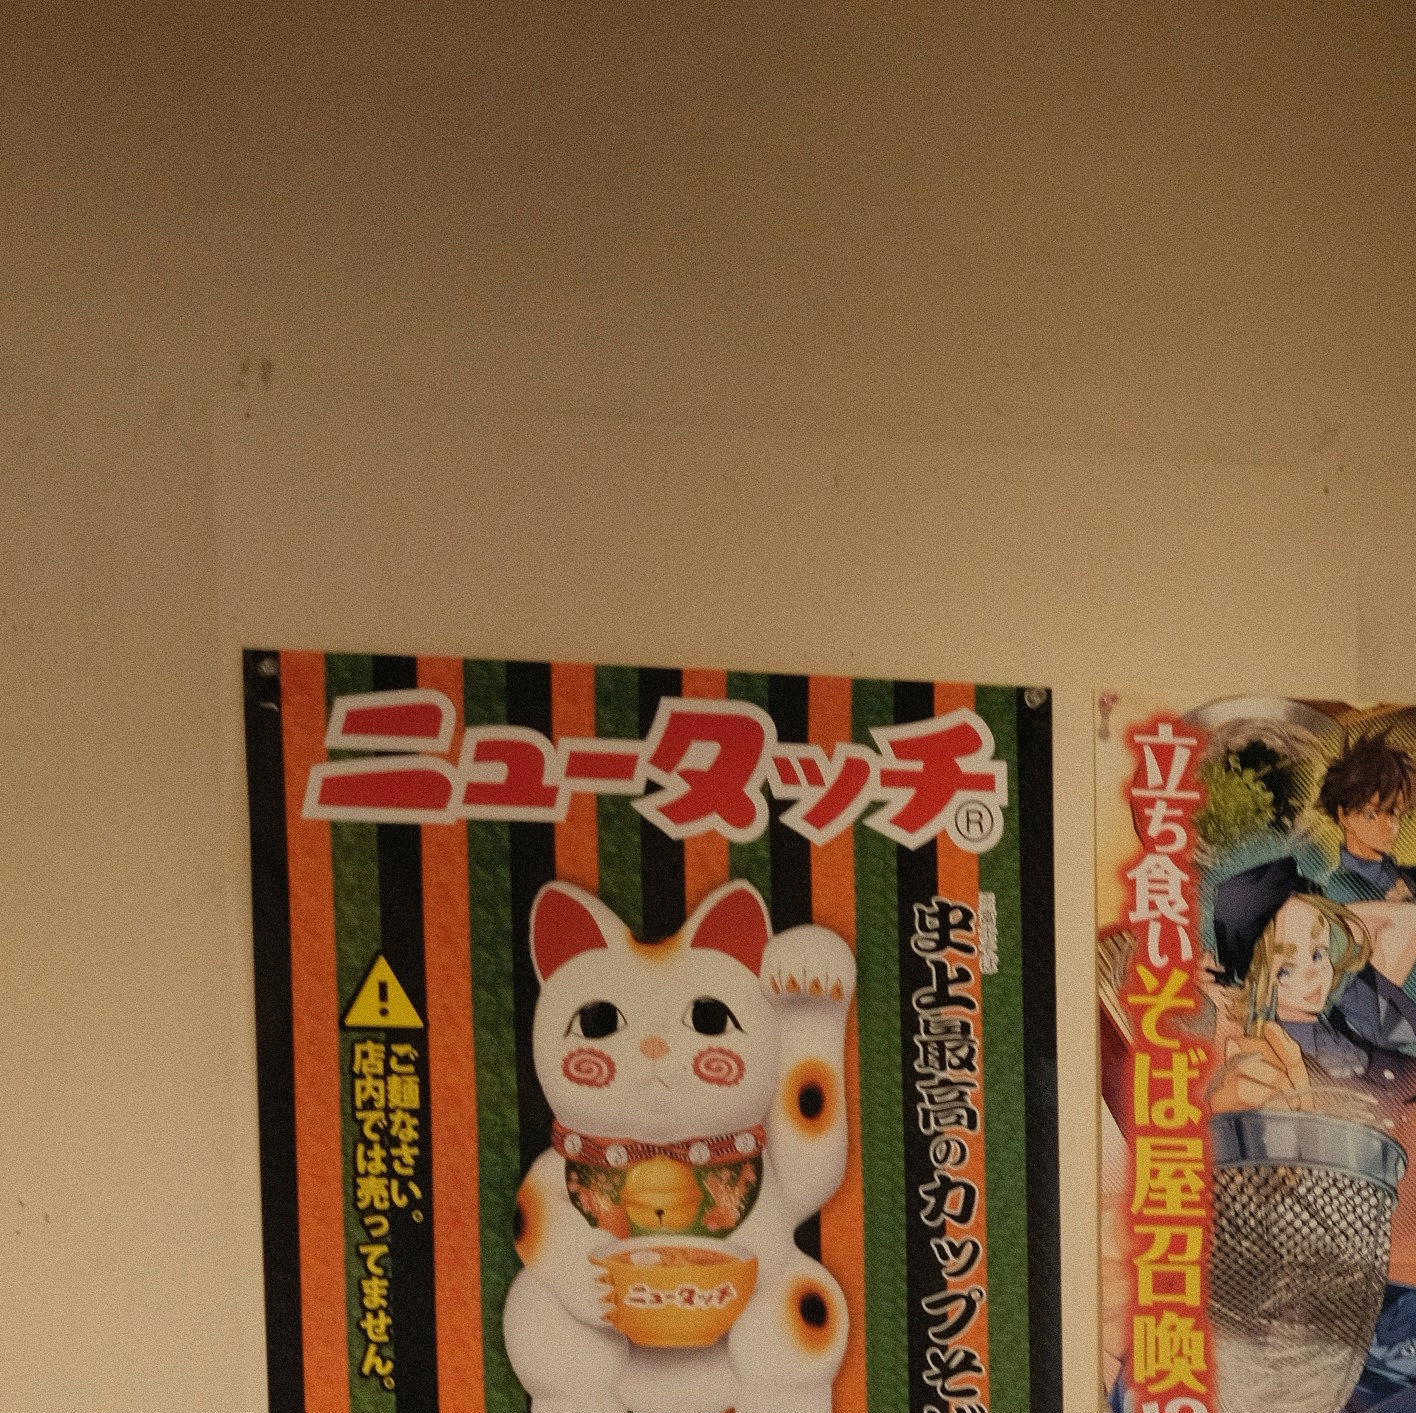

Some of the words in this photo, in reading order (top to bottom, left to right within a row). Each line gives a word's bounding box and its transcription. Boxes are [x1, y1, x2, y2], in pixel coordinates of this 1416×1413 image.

[302, 688, 1007, 850] ニュータッチ
[353, 1040, 395, 1390] 店内では売ってません。
[386, 1042, 424, 1223] ご麺なさい。
[624, 1281, 737, 1309] ニュータッチ
